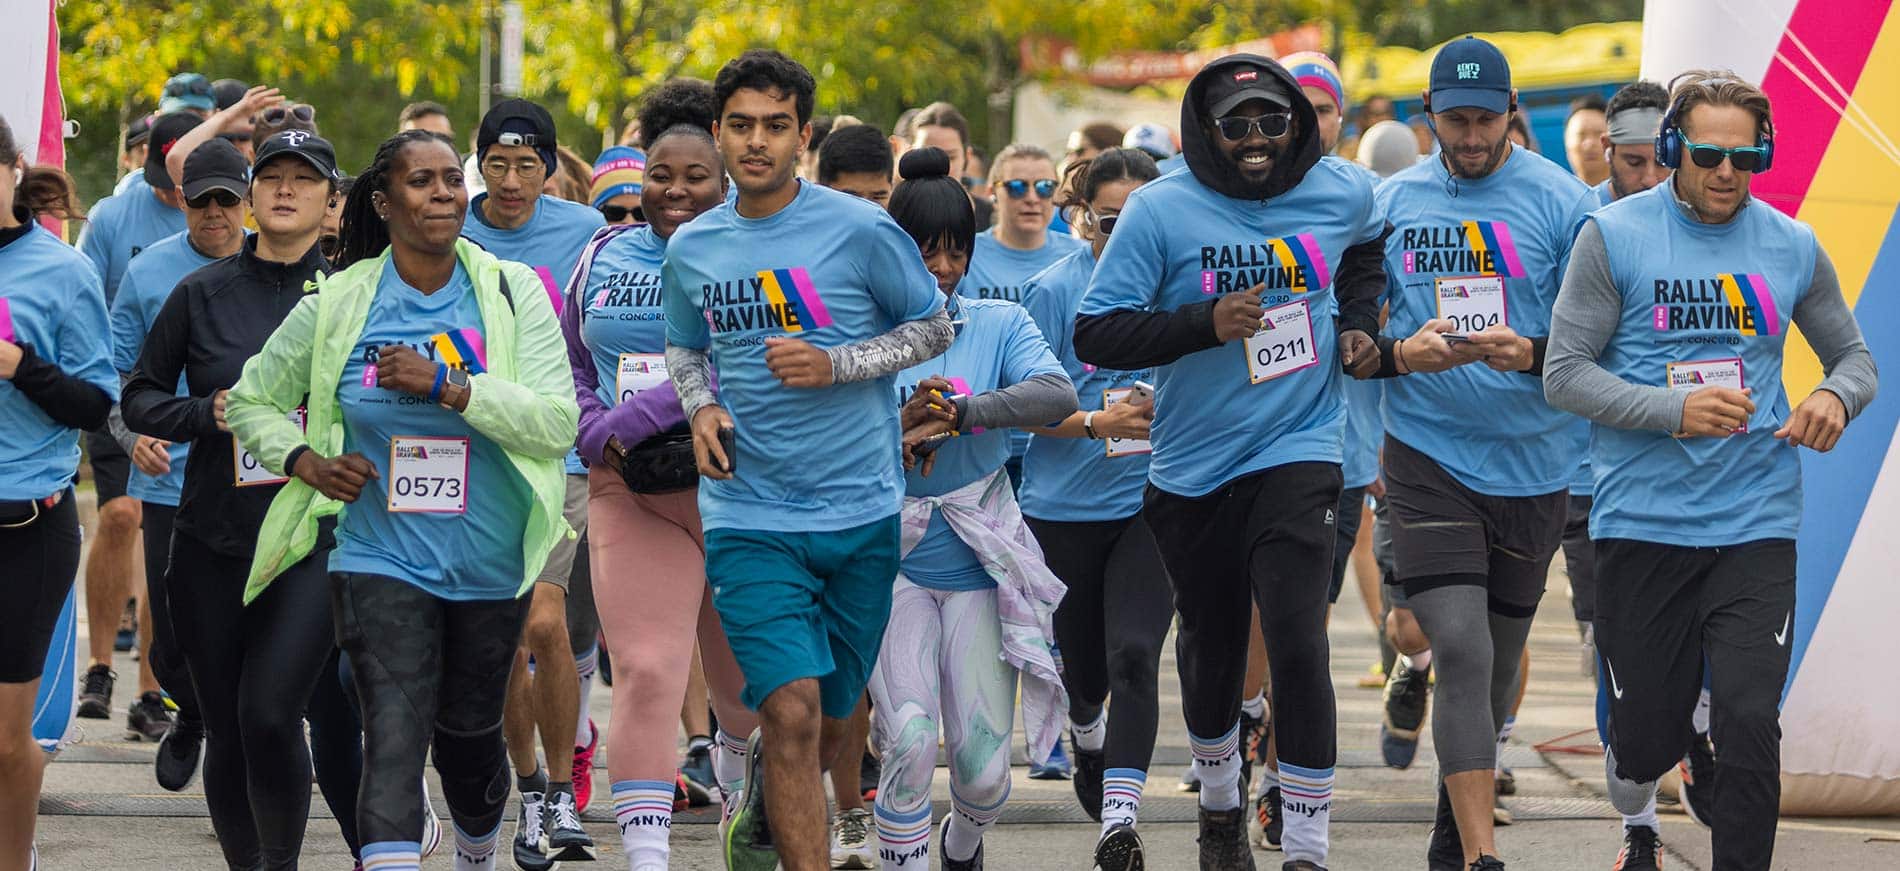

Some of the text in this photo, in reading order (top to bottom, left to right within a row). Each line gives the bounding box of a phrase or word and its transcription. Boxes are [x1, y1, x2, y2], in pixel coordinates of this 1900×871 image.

[1403, 226, 1468, 250] RALLY
[1201, 244, 1275, 268] RALLY
[1415, 249, 1497, 273] RAVINE
[1216, 264, 1307, 293] RAVINE
[604, 288, 663, 307] RAVI
[702, 277, 765, 309] RALLY
[979, 286, 1021, 302] RALL
[1261, 294, 1290, 305] CORD
[1653, 279, 1725, 303] RALLY
[712, 301, 799, 333] RAVINE
[1447, 312, 1499, 332] 0104
[1669, 305, 1756, 330] RAVINE
[1257, 337, 1306, 366] 0211
[398, 396, 433, 405] CONC
[395, 476, 461, 498] 0573
